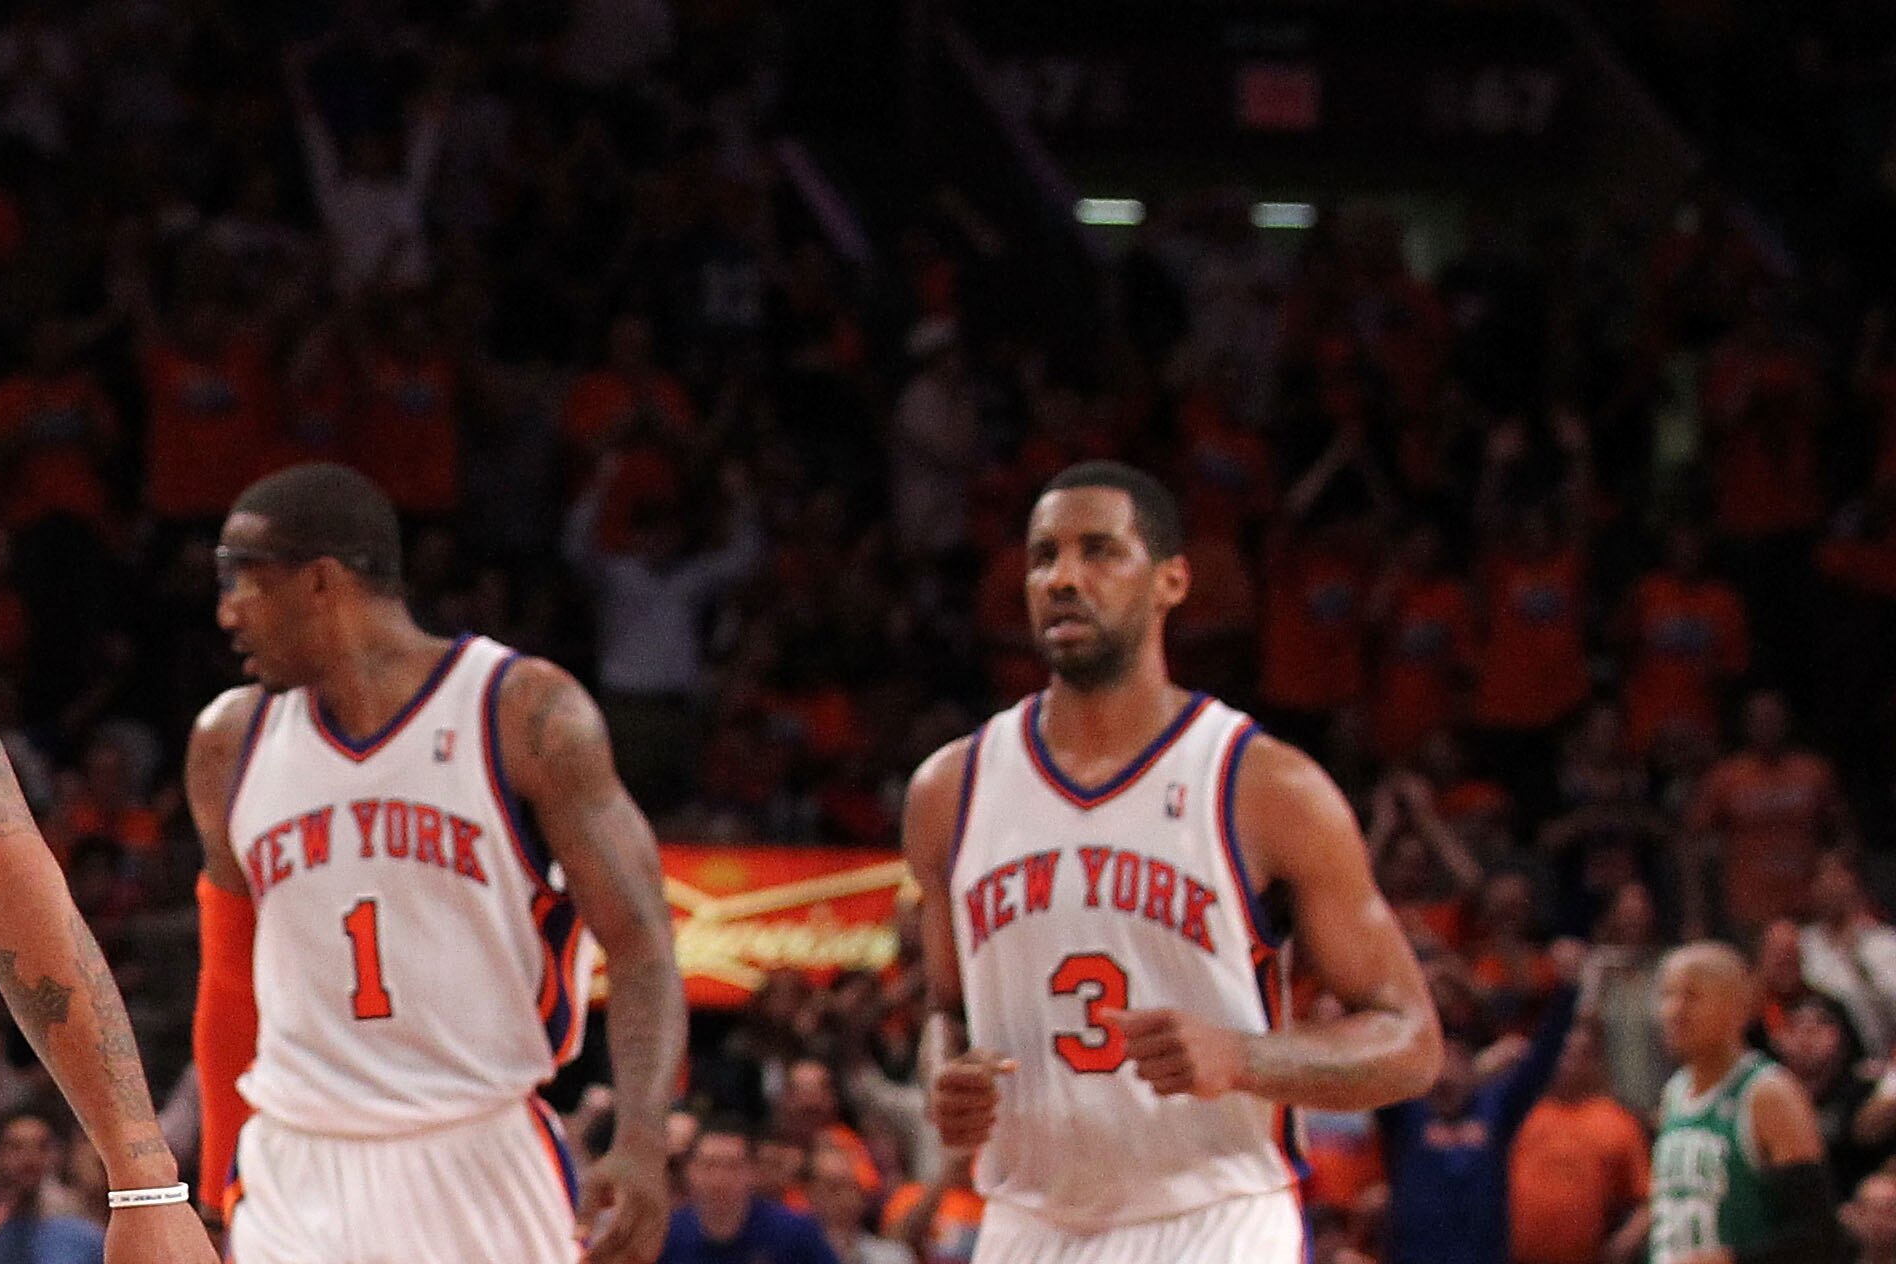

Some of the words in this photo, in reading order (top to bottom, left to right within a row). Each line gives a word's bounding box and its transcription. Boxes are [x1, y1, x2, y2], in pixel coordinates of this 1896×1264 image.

[245, 804, 334, 897] NEW
[350, 798, 489, 887] YORK
[965, 849, 1061, 955] NEW
[1077, 846, 1218, 956] YORK
[342, 897, 393, 1021] 1
[1049, 952, 1130, 1074] 3
